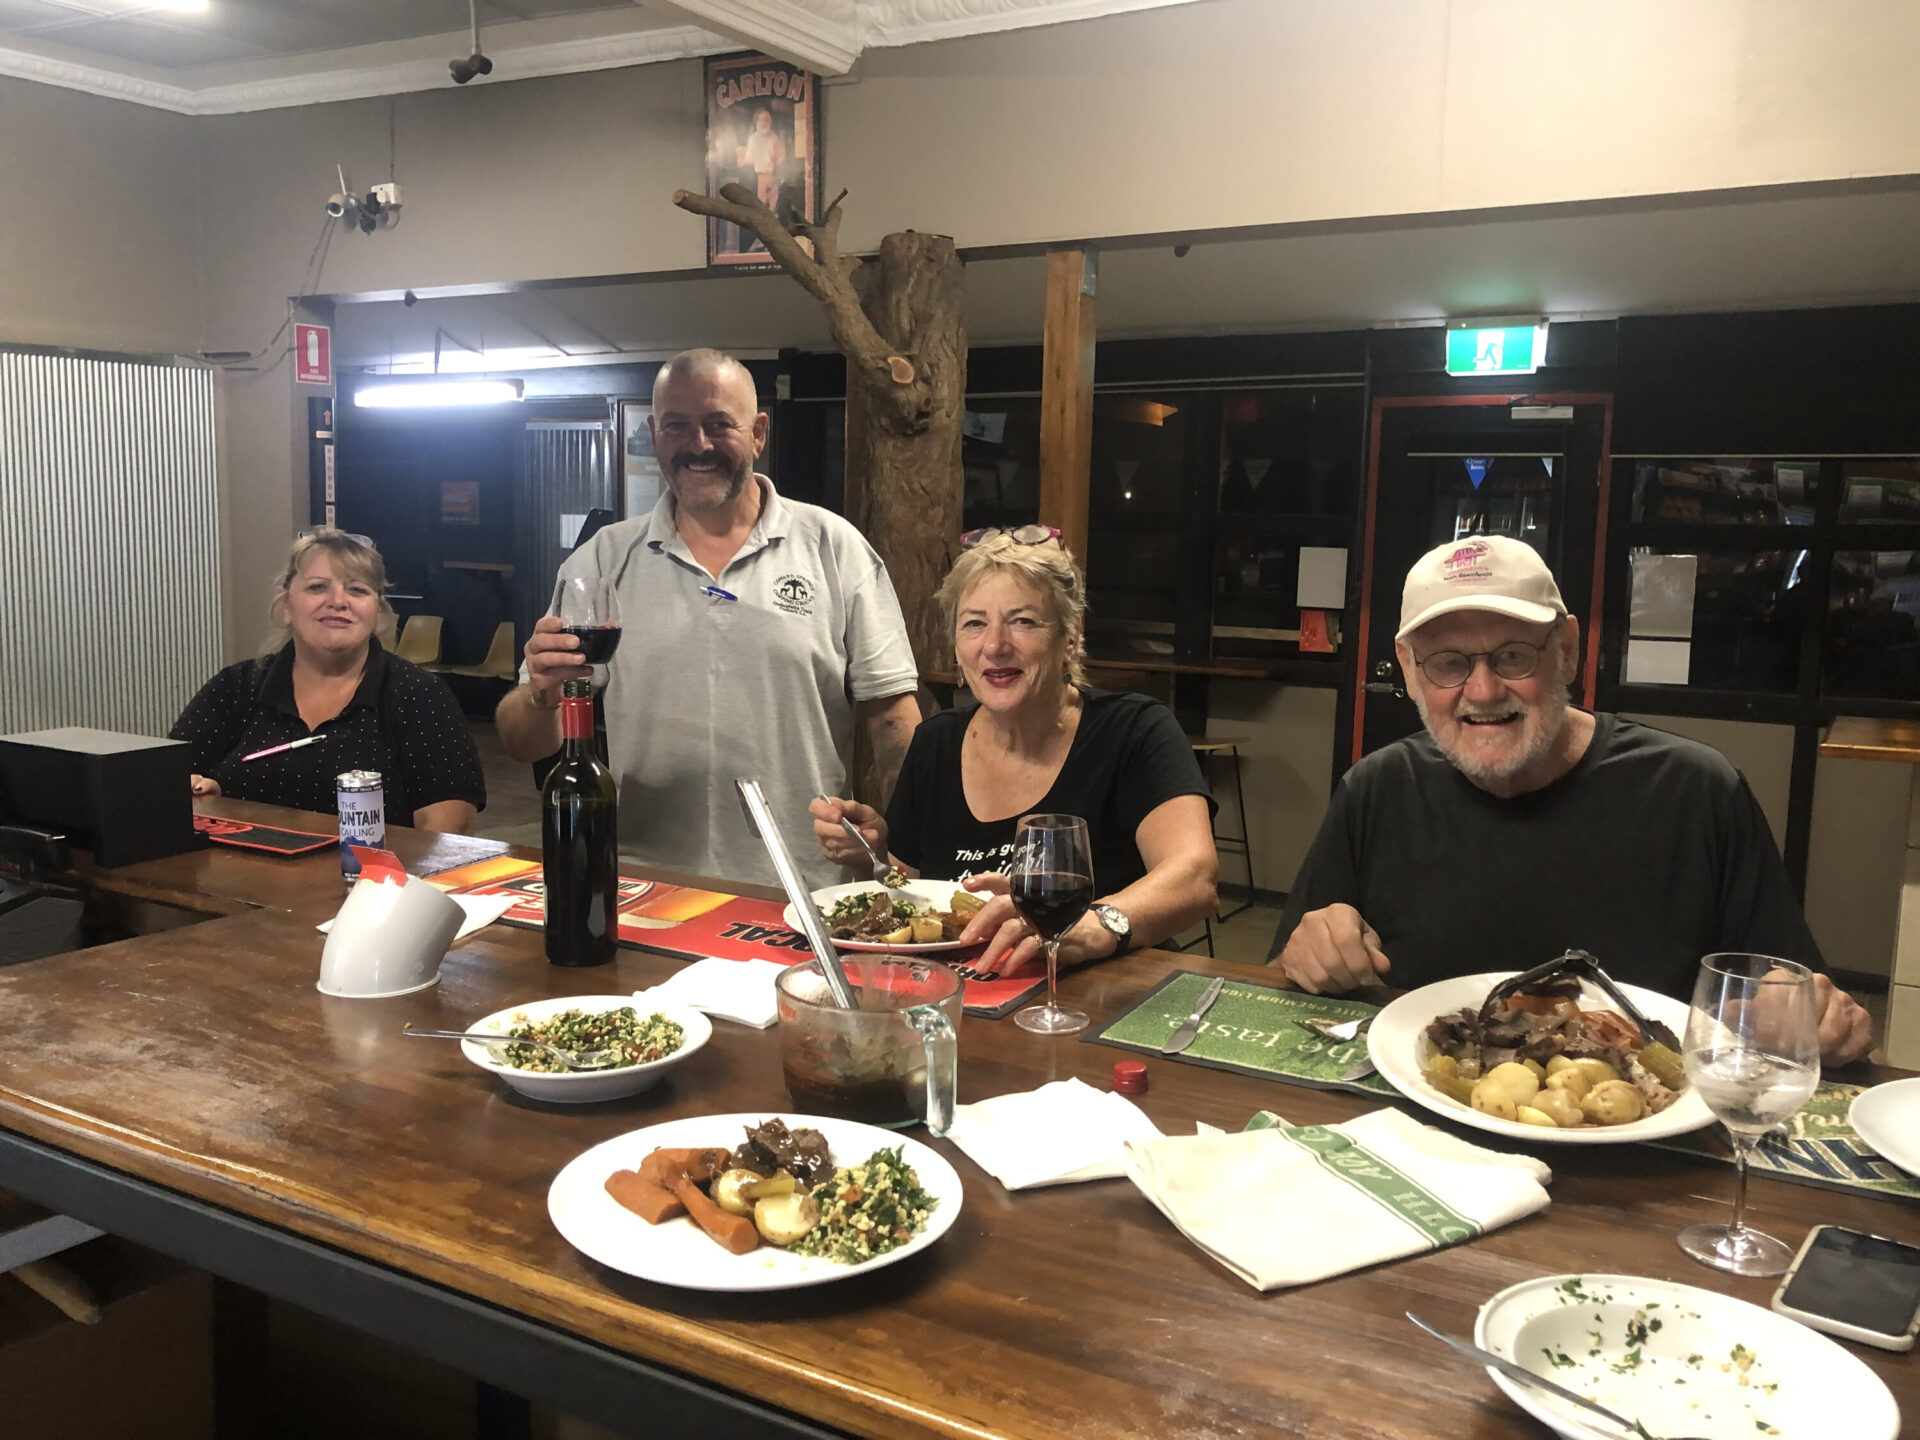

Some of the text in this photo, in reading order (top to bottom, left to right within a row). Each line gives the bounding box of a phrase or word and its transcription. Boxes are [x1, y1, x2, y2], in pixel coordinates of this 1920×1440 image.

[716, 70, 805, 108] CARLTON
[341, 801, 357, 811] THE
[339, 809, 380, 826] UNTAIN
[340, 827, 375, 838] CALLING
[955, 849, 985, 861] This
[720, 921, 816, 953] OCAL
[1220, 987, 1254, 1000] LIGH
[1257, 993, 1329, 1011] PREMIUM
